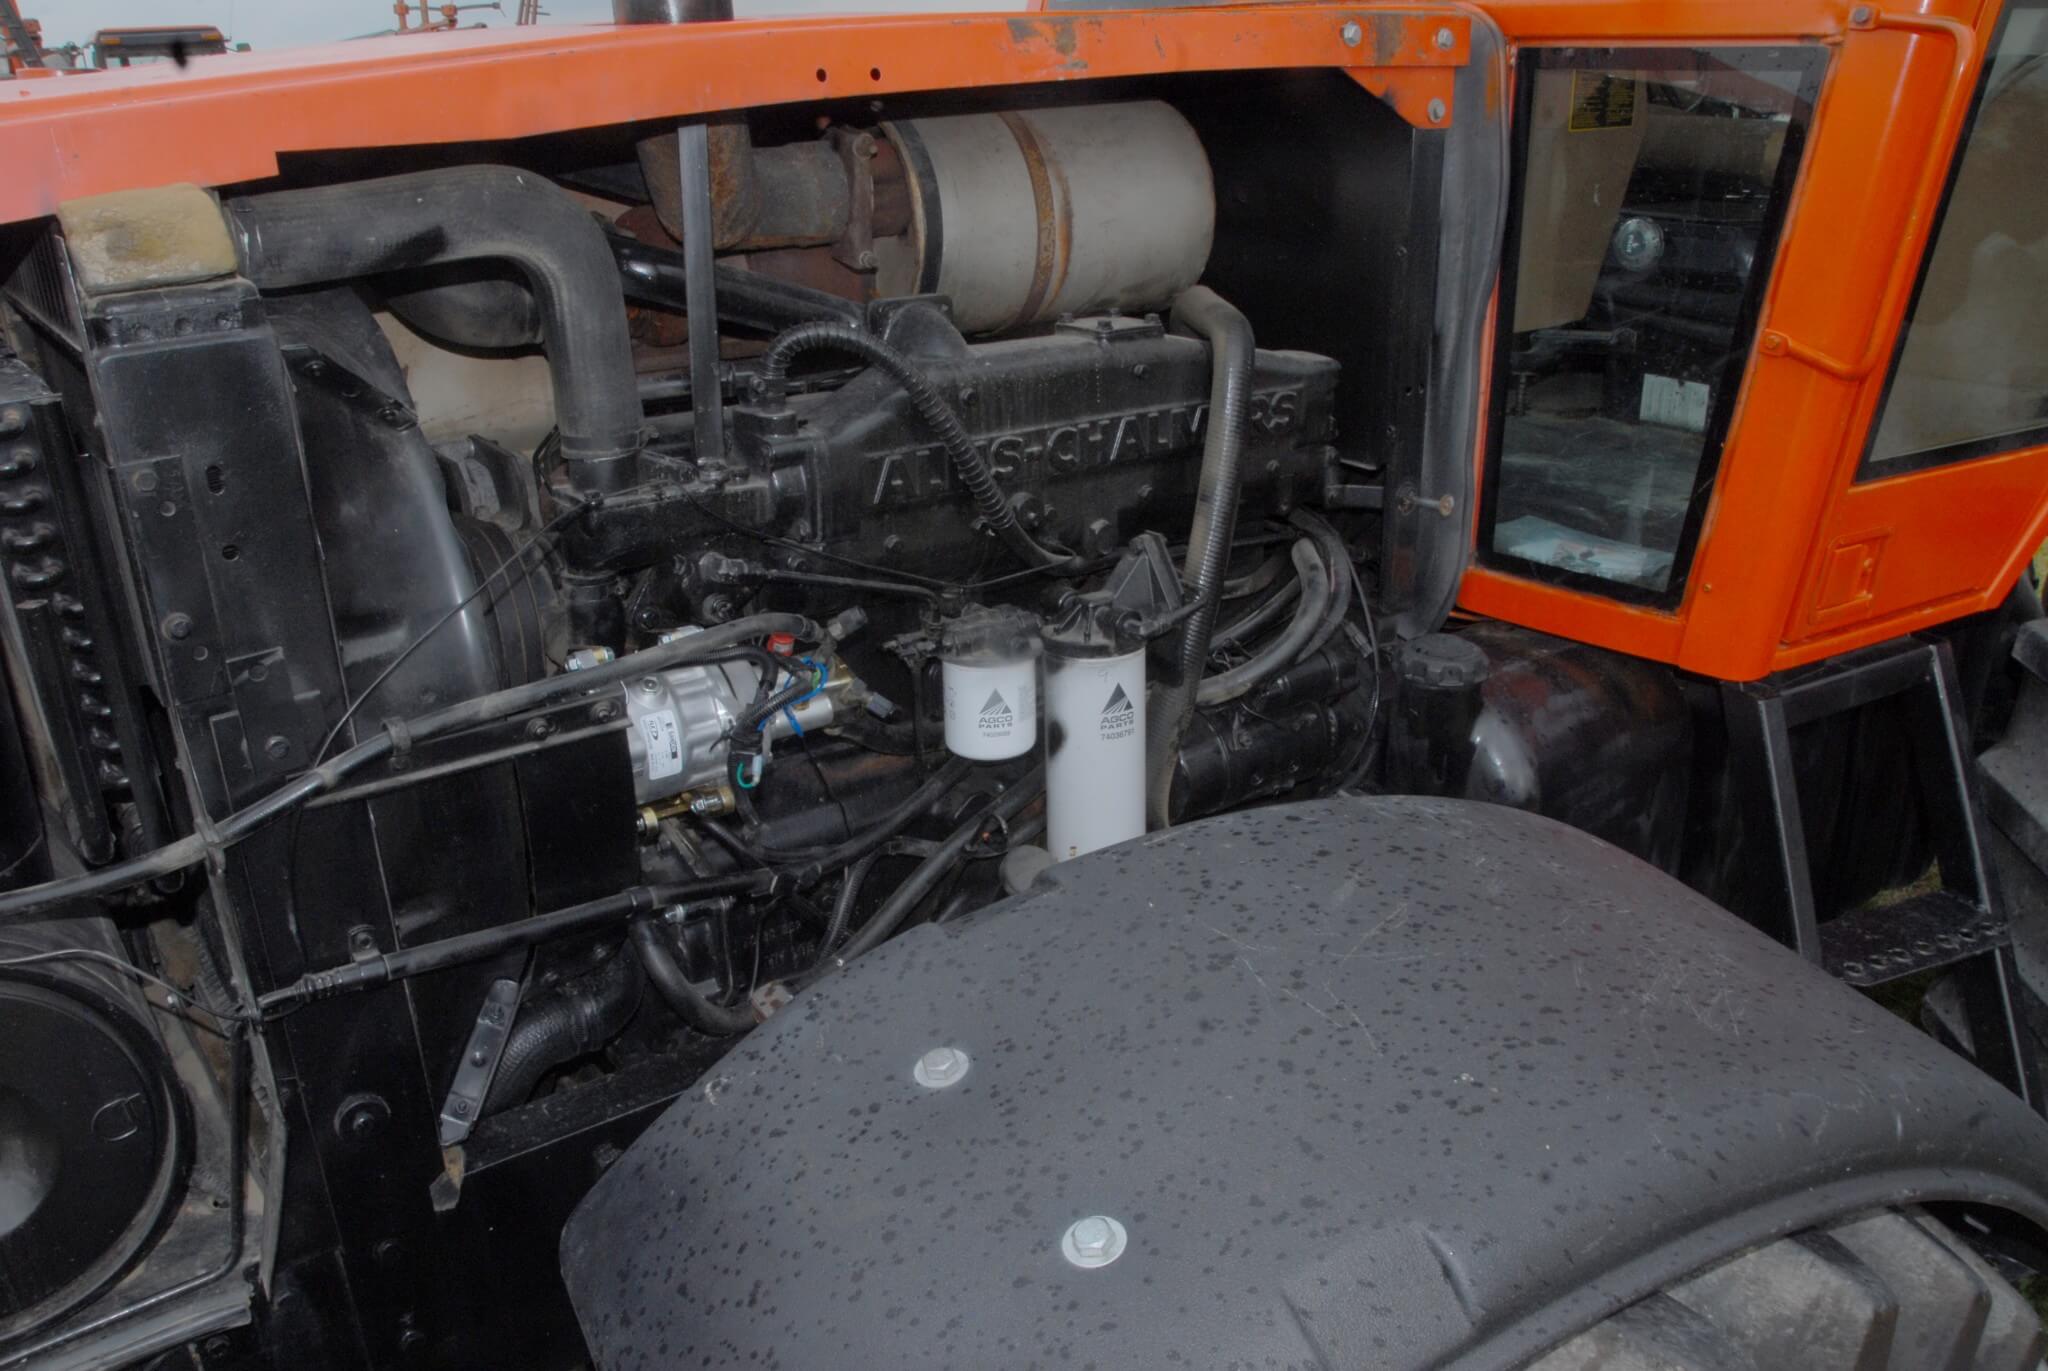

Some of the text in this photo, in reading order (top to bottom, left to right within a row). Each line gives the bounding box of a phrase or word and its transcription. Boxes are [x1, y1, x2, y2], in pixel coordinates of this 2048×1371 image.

[979, 715, 1013, 724] AGCO
[1100, 711, 1134, 724] AGCO
[1100, 720, 1134, 730] PARTS
